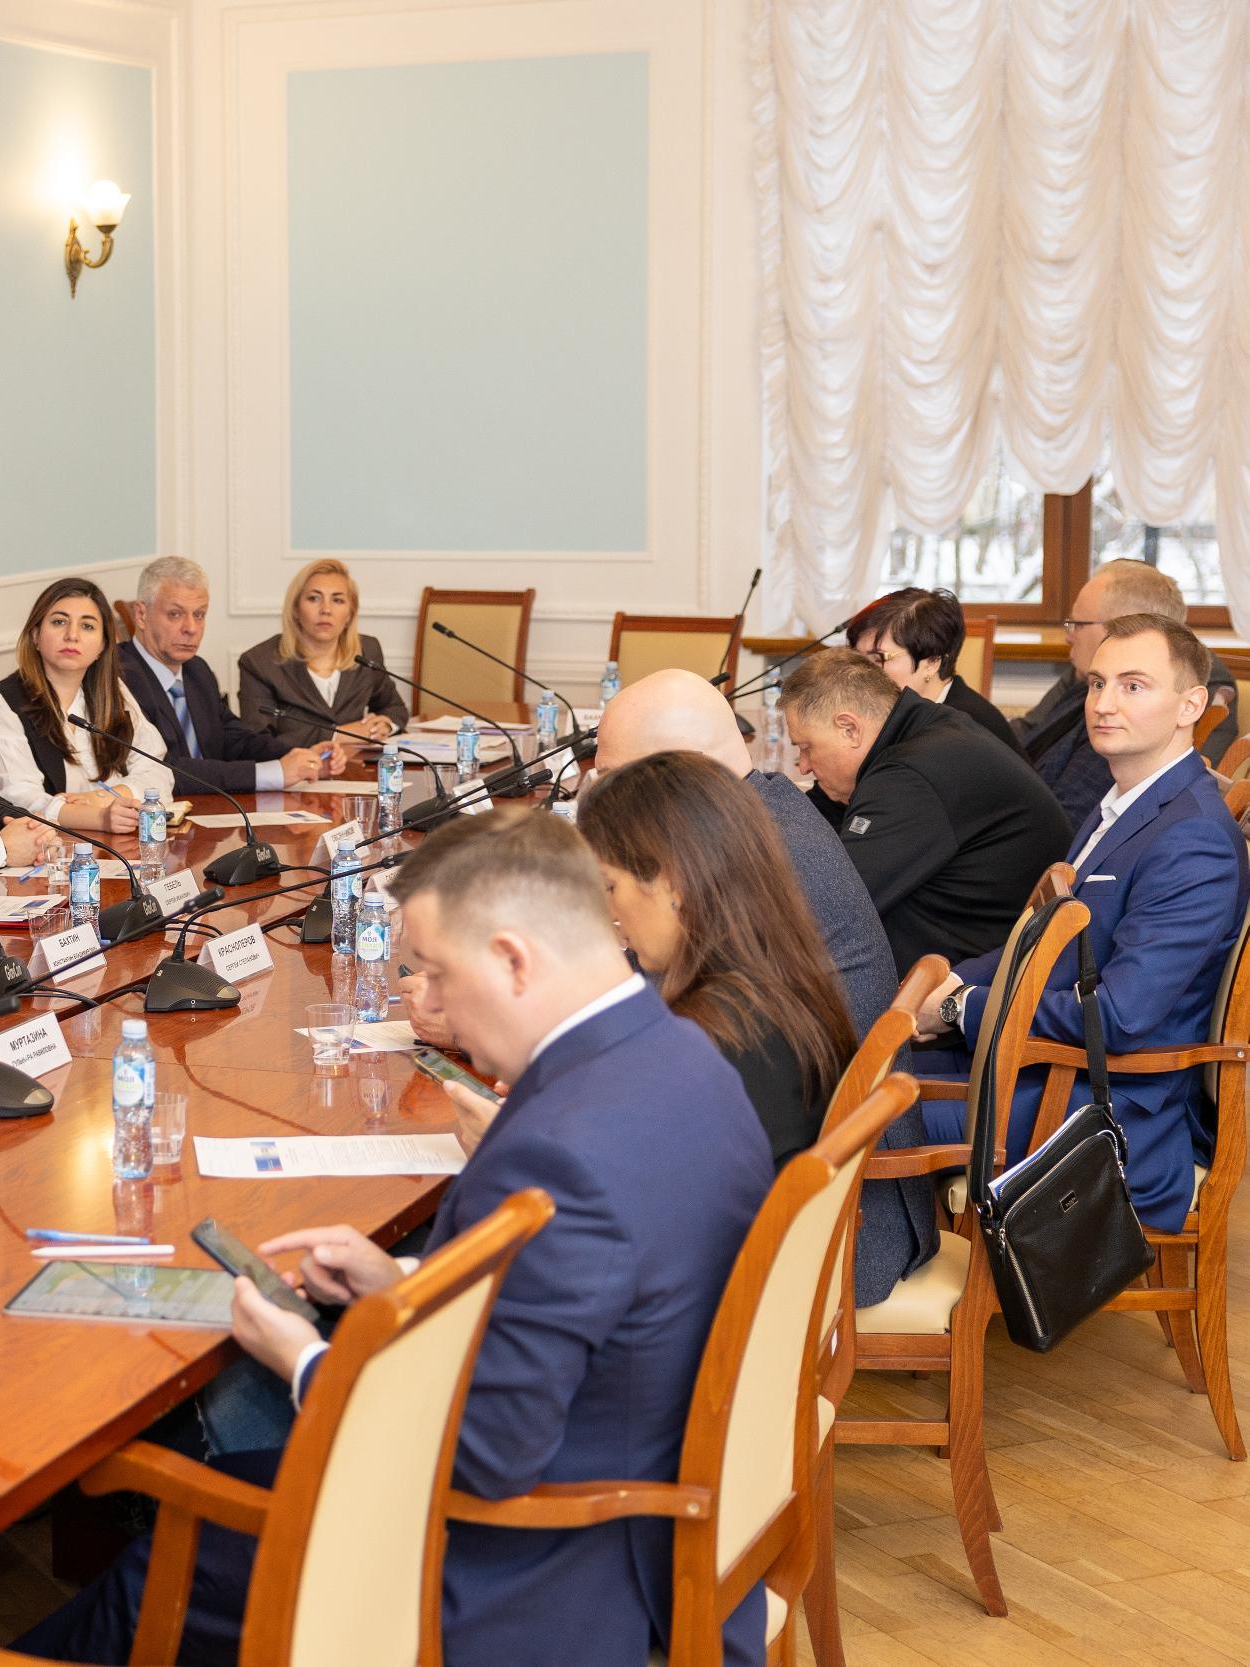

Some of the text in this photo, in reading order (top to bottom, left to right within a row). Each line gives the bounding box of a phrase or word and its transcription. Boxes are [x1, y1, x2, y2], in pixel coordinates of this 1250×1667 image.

[58, 933, 81, 948] БАХТИН
[217, 935, 256, 957] КРАСНОПЕРОВ
[9, 1027, 48, 1052] МУРТАЗИНА
